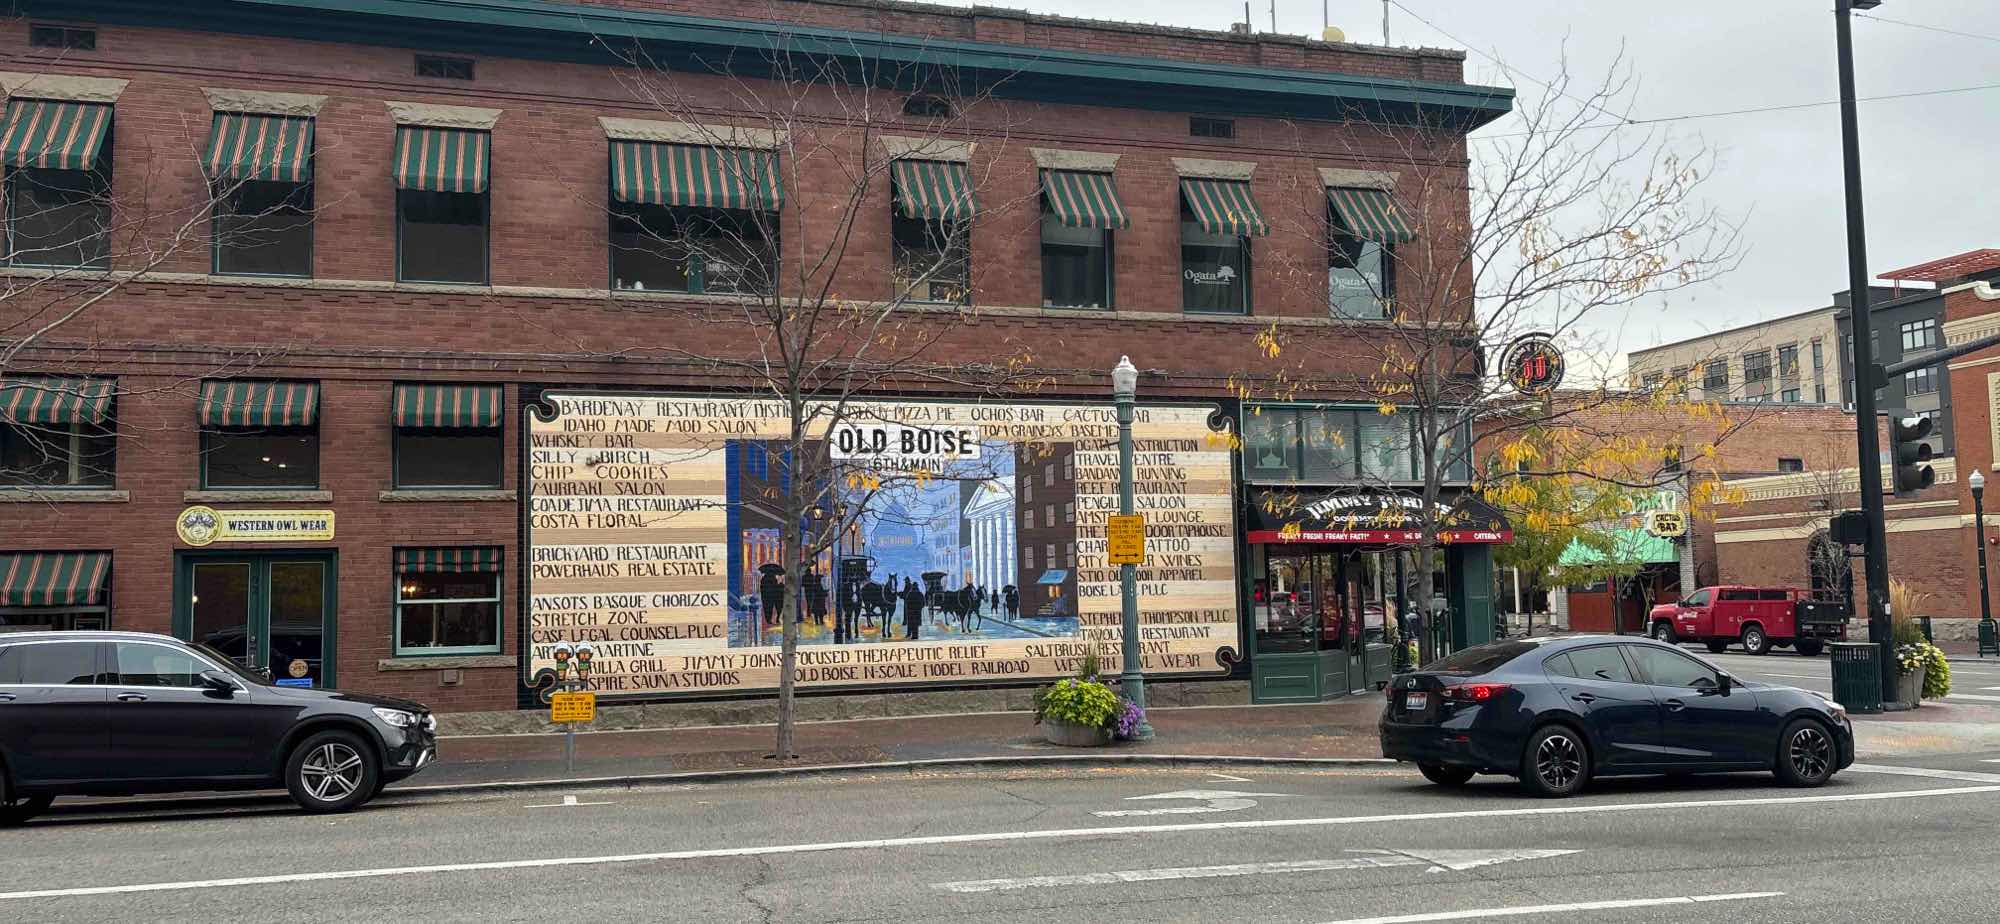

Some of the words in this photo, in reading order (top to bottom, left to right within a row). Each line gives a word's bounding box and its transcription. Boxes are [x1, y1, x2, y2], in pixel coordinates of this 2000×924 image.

[1184, 269, 1217, 284] Ogata
[561, 400, 643, 417] BARDENAY
[895, 406, 931, 420] PIZZA
[936, 407, 956, 421] PIE
[971, 407, 1013, 422] OCHOS
[1021, 408, 1045, 422] BAR
[1063, 409, 1117, 423] CACTUS
[1134, 410, 1150, 423] AR
[564, 418, 606, 432] IDAHO
[614, 419, 656, 433] MADE
[665, 420, 701, 433] MOD
[707, 419, 758, 433] SALON
[531, 434, 595, 448] WHISKEY
[605, 434, 634, 448] BAR
[838, 428, 887, 455] OLD
[901, 428, 973, 455] BOISE
[1075, 438, 1111, 451] OGATA
[1118, 438, 1198, 452] NSTRUCTION
[532, 450, 577, 464] SILLY
[600, 450, 650, 464] BIRCH
[1076, 453, 1120, 466] TRAVEL
[1131, 453, 1175, 466] ENTRE
[531, 465, 574, 479] CHIP
[595, 465, 669, 479] COOKIES
[1137, 467, 1187, 480] RUNNING
[615, 481, 665, 496] SALON
[1075, 481, 1104, 494] REEF
[1111, 481, 1188, 495] RTAURANT
[617, 498, 703, 512] RESTAURANT
[1137, 496, 1186, 509] SALOON
[1306, 495, 1372, 520] JIMMY
[228, 520, 274, 531] WESTERN
[277, 520, 298, 530] OWL
[300, 520, 327, 530] WEAR
[531, 513, 579, 528] COSTA
[587, 513, 648, 528] FLORAL
[1659, 522, 1679, 532] BAR
[1144, 525, 1175, 537] DOOR
[1175, 525, 1227, 538] TAPHOUSE
[1144, 538, 1190, 552] ATTOO
[532, 546, 609, 561] BRICKYARD
[617, 545, 707, 560] RESTAURANT
[1077, 555, 1104, 568] CITY
[1160, 554, 1202, 567] WINES
[533, 562, 620, 579] POWERHAUS
[628, 562, 659, 577] REAL
[663, 561, 716, 576] ESTATE
[1078, 570, 1104, 582] STIO
[1159, 568, 1207, 581] APPAREL
[1078, 584, 1108, 597] BOISE
[1141, 584, 1168, 596] PLLC
[532, 596, 588, 610] ANSOTS
[593, 595, 647, 609] BASQUE
[652, 593, 720, 608] CHORIZOS
[532, 612, 597, 627] STRETCH
[607, 610, 648, 625] ZONE
[1143, 611, 1199, 625] THOMPSON
[1203, 609, 1230, 623] PLLC
[531, 629, 566, 643] CASE
[571, 628, 614, 642] LEGAL
[687, 624, 721, 638] PLLC
[1142, 626, 1210, 640] RESTAURANT
[629, 659, 666, 674] GRILL
[682, 654, 736, 670] JIMMY
[741, 653, 783, 668] JOHNS
[855, 646, 943, 664] THERAPEUTIC
[949, 645, 989, 659] RELIEF
[1025, 642, 1091, 657] SALTBRUSH
[1098, 641, 1170, 656] RESTRANT
[631, 673, 680, 689] SAUNA
[681, 671, 740, 687] STUDIOS
[794, 668, 819, 682] OLD
[821, 666, 858, 681] BOISE
[864, 664, 918, 679] N-SCALE
[923, 663, 966, 677] MODEL
[971, 660, 1030, 675] RAILROAD
[1160, 654, 1201, 670] WEAR
